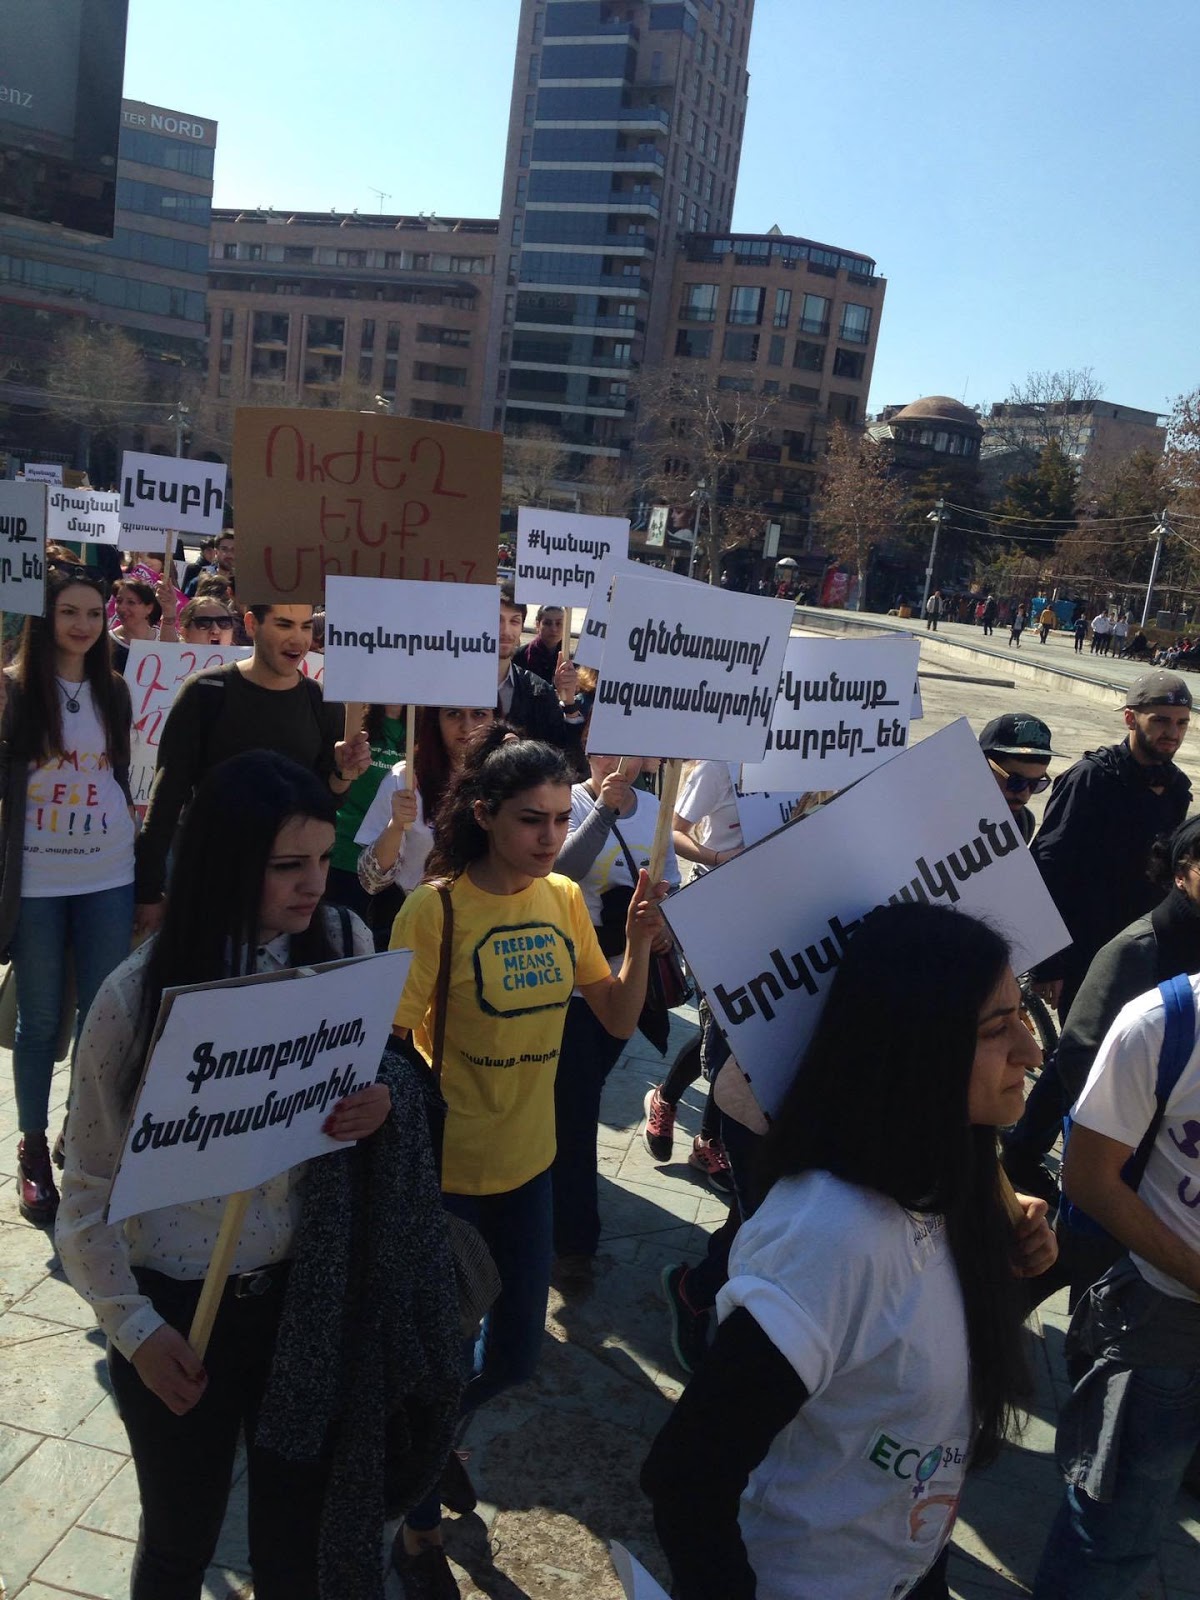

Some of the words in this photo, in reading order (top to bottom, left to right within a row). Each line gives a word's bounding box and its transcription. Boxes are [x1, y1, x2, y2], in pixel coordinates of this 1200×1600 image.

[122, 111, 146, 125] TER
[150, 113, 204, 139] NORD
[123, 469, 223, 517] լեսբի
[68, 517, 105, 537] մայր
[0, 552, 43, 583] ր_են
[518, 564, 595, 588] տարբեր
[328, 624, 496, 658] հոգևորական
[628, 618, 770, 675] զինծառայող/
[599, 680, 772, 727] ազատամարտիկ
[713, 818, 1019, 1025] երկսեական
[493, 934, 556, 956] FREEDOM
[504, 952, 554, 971] MEANS
[503, 968, 563, 991] CHOICE
[186, 1018, 366, 1093] Ֆուտբոլիստ,
